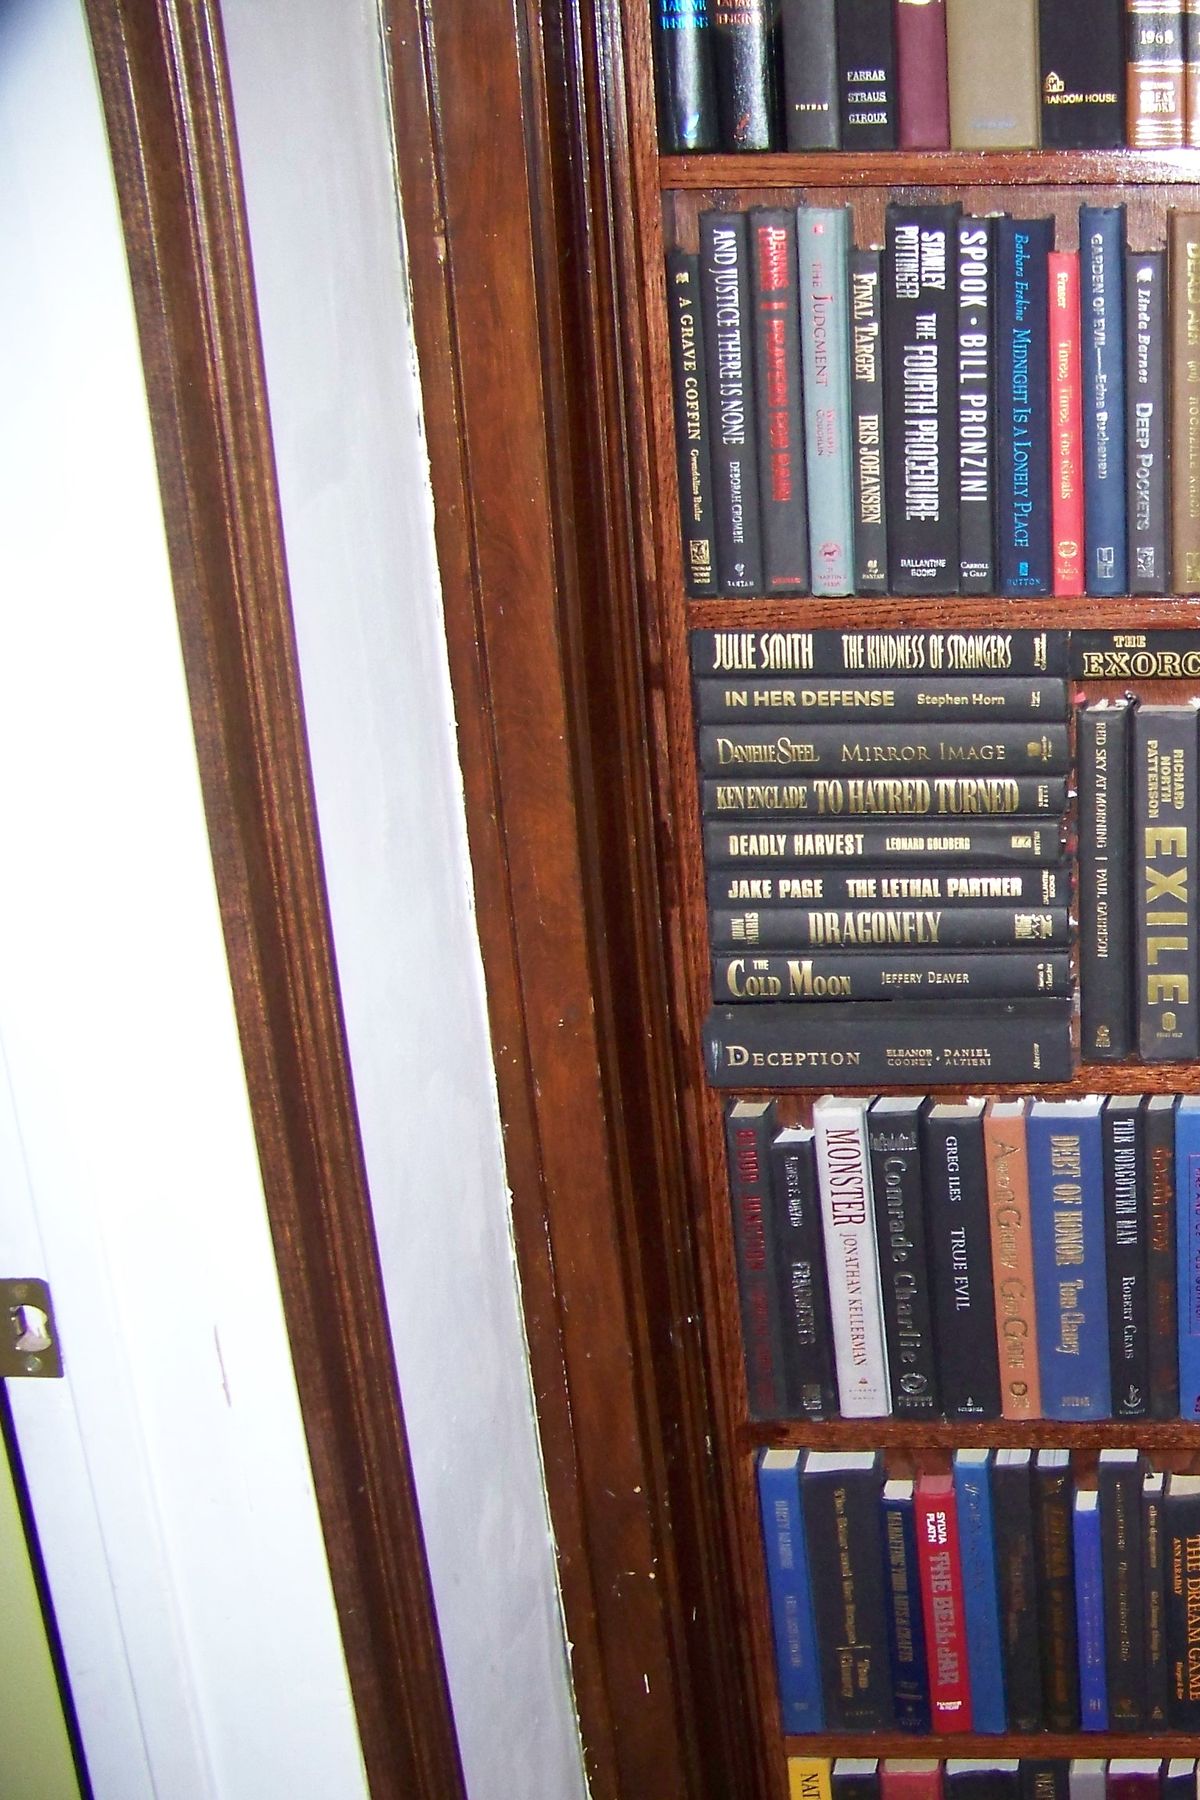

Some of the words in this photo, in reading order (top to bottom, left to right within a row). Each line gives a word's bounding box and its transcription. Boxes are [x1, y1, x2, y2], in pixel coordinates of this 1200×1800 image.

[1141, 30, 1174, 45] 1968
[847, 70, 886, 82] FARRAR
[848, 91, 887, 102] STRAUS
[849, 112, 887, 124] GIROUX
[1044, 93, 1082, 104] RANDOM
[1084, 93, 1117, 103] HOUSE
[713, 230, 736, 265] AND
[895, 227, 919, 298] POTTINGER
[921, 232, 945, 290] STANLEY
[1015, 233, 1029, 277] Barbara
[960, 231, 988, 307] SPOOK
[679, 297, 691, 308] A
[709, 268, 738, 327] JUSTICE
[853, 273, 878, 319] FINAL
[1015, 282, 1030, 321] Erskine
[681, 314, 696, 371] GRAVE
[915, 314, 937, 340] THE
[719, 330, 740, 379] THERE
[855, 324, 878, 382] TARGET
[960, 334, 987, 383] BILL
[721, 383, 742, 397] IS
[904, 345, 938, 413] FOURTH
[685, 378, 700, 440] COFFIN
[721, 401, 744, 444] NONE
[859, 415, 878, 444] IRIS
[960, 395, 988, 501] PRONZINI
[729, 462, 741, 502] DEBORAH
[860, 448, 880, 523] JOHANSEN
[904, 419, 939, 521] PROCEDURE
[1013, 441, 1030, 497] LONELY
[731, 504, 743, 543] CROMBIE
[1014, 502, 1031, 547] PLACE
[713, 634, 756, 670] JULIE
[760, 634, 813, 670] SMITH
[842, 635, 865, 669] THE
[868, 635, 925, 669] KINDNESS
[929, 635, 944, 669] OF
[948, 635, 1012, 668] STRANGERS
[1114, 636, 1146, 648] THE
[725, 692, 747, 706] IN
[754, 692, 796, 706] HER
[801, 691, 894, 706] DEFENSE
[917, 694, 968, 706] Stephen
[972, 695, 1004, 705] Horn
[842, 744, 929, 762] MIRROR
[940, 742, 1005, 760] IMAGE
[717, 786, 746, 810] KEN
[748, 786, 807, 809] ENGLADE
[814, 781, 843, 814] TO
[848, 780, 930, 814] HATRED
[935, 779, 1019, 814] TURNED
[1147, 740, 1159, 818] PATTERSON
[1161, 756, 1171, 802] NORTH
[1174, 749, 1184, 809] RICHARD
[729, 835, 786, 855] DEADLY
[794, 834, 864, 855] HARVEST
[886, 838, 925, 850] LEONARD
[928, 838, 970, 850] GOLDBERG
[728, 880, 772, 898] JAKE
[779, 879, 823, 898] PAGE
[846, 879, 876, 898] THE
[882, 879, 940, 898] LETHAL
[947, 878, 1022, 897] PARTNER
[808, 912, 941, 944] DRAGONFLY
[1145, 827, 1189, 1004] EXILE
[752, 960, 769, 970] THE
[882, 972, 922, 984] JEFFERY
[928, 972, 969, 983] DEAVER
[726, 1046, 859, 1067] DECEPTION
[945, 1136, 958, 1172] GREG
[1051, 1135, 1081, 1177] DEBT
[826, 1129, 866, 1226] MONSTER
[948, 1177, 960, 1201] ILES
[1054, 1184, 1082, 1204] OF
[883, 1157, 914, 1262] Comrade
[950, 1227, 968, 1270] TRUE
[1055, 1211, 1084, 1265] HONOR
[840, 1233, 862, 1295] JONATHAN
[954, 1276, 970, 1311] EVIL
[1059, 1280, 1084, 1307] Tom
[849, 1300, 867, 1366] KELLERMAN
[894, 1271, 922, 1363] Charlie
[1056, 1313, 1086, 1356] Clancy
[927, 1513, 936, 1542] PLATH
[936, 1512, 946, 1544] SYLVIA
[929, 1552, 952, 1593] THE
[932, 1597, 956, 1644] BELL
[938, 1647, 958, 1685] JAR
